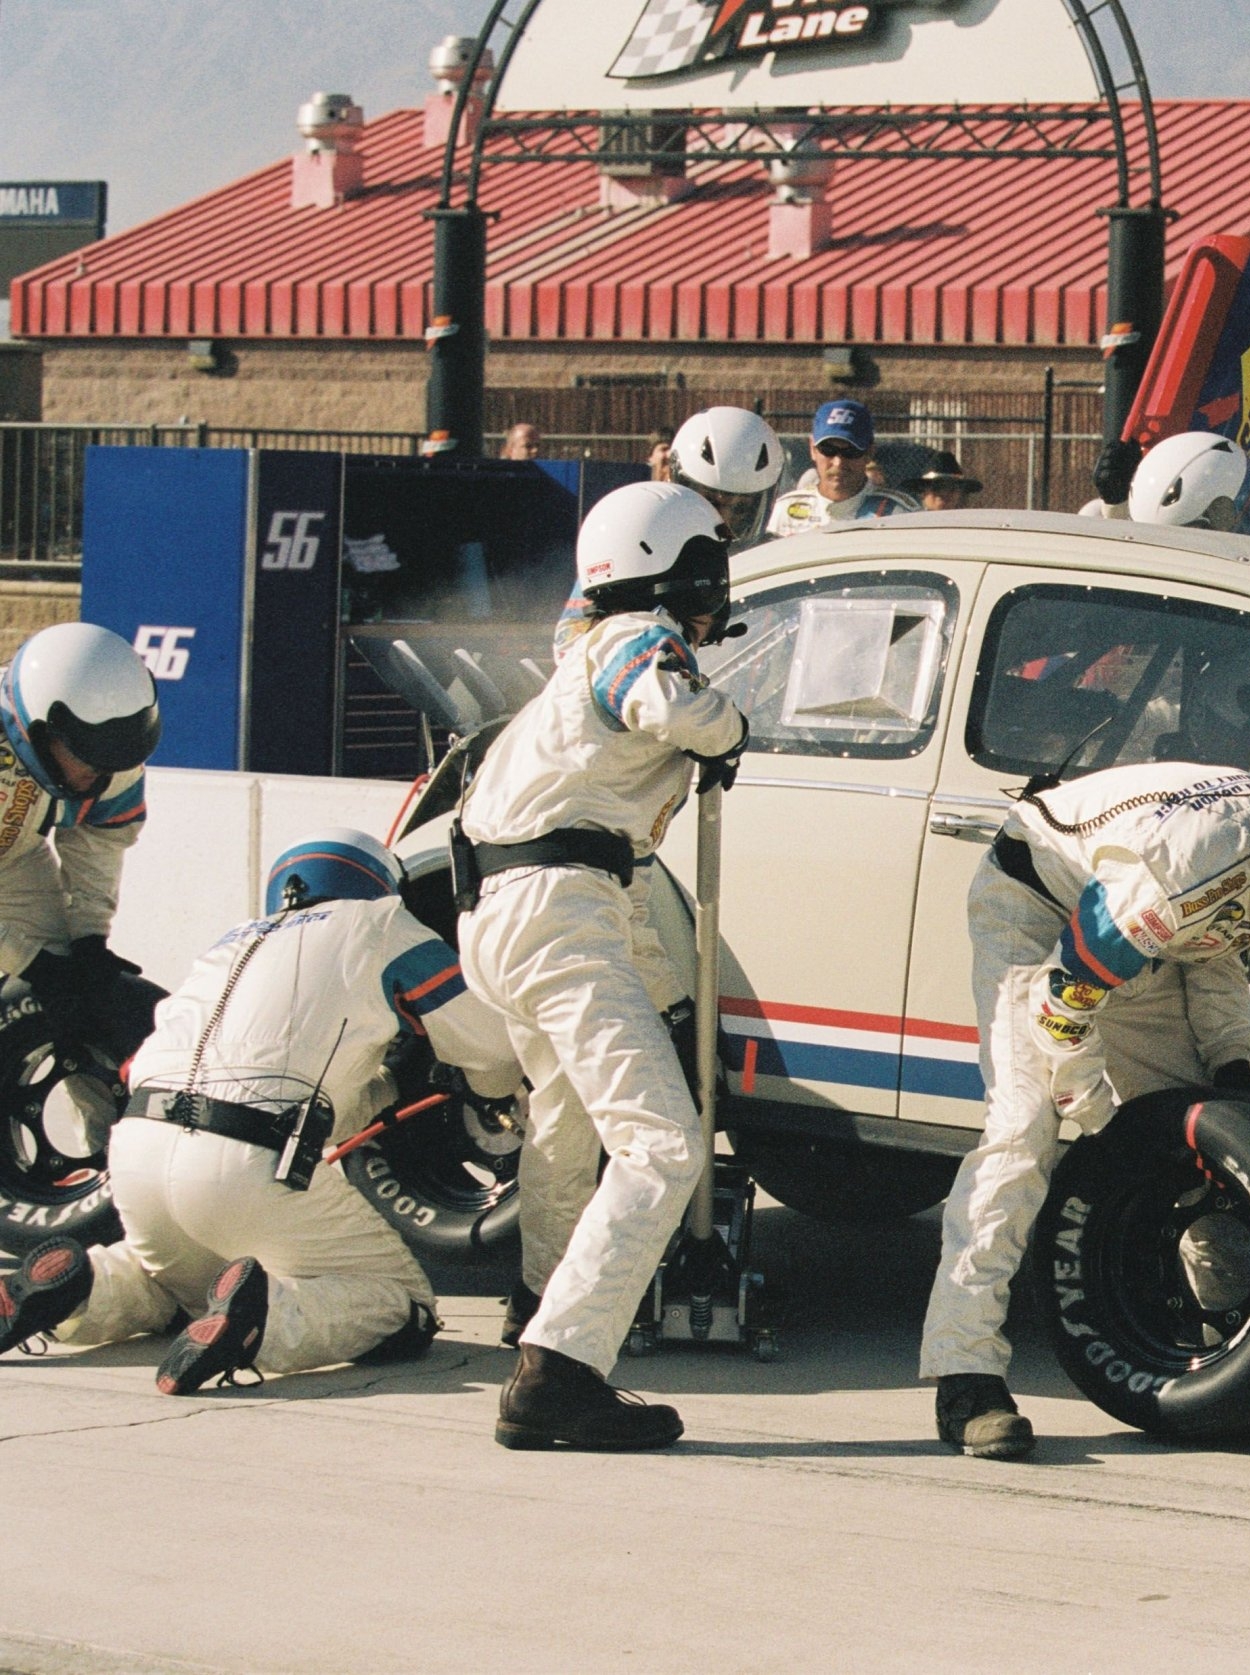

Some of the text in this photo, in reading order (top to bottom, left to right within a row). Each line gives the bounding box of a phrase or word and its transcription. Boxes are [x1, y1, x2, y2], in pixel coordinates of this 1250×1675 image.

[737, 6, 869, 49] Lane
[827, 408, 857, 424] 56
[261, 510, 326, 571] 56
[133, 625, 196, 681] 56
[1040, 1016, 1087, 1035] SUNOCO
